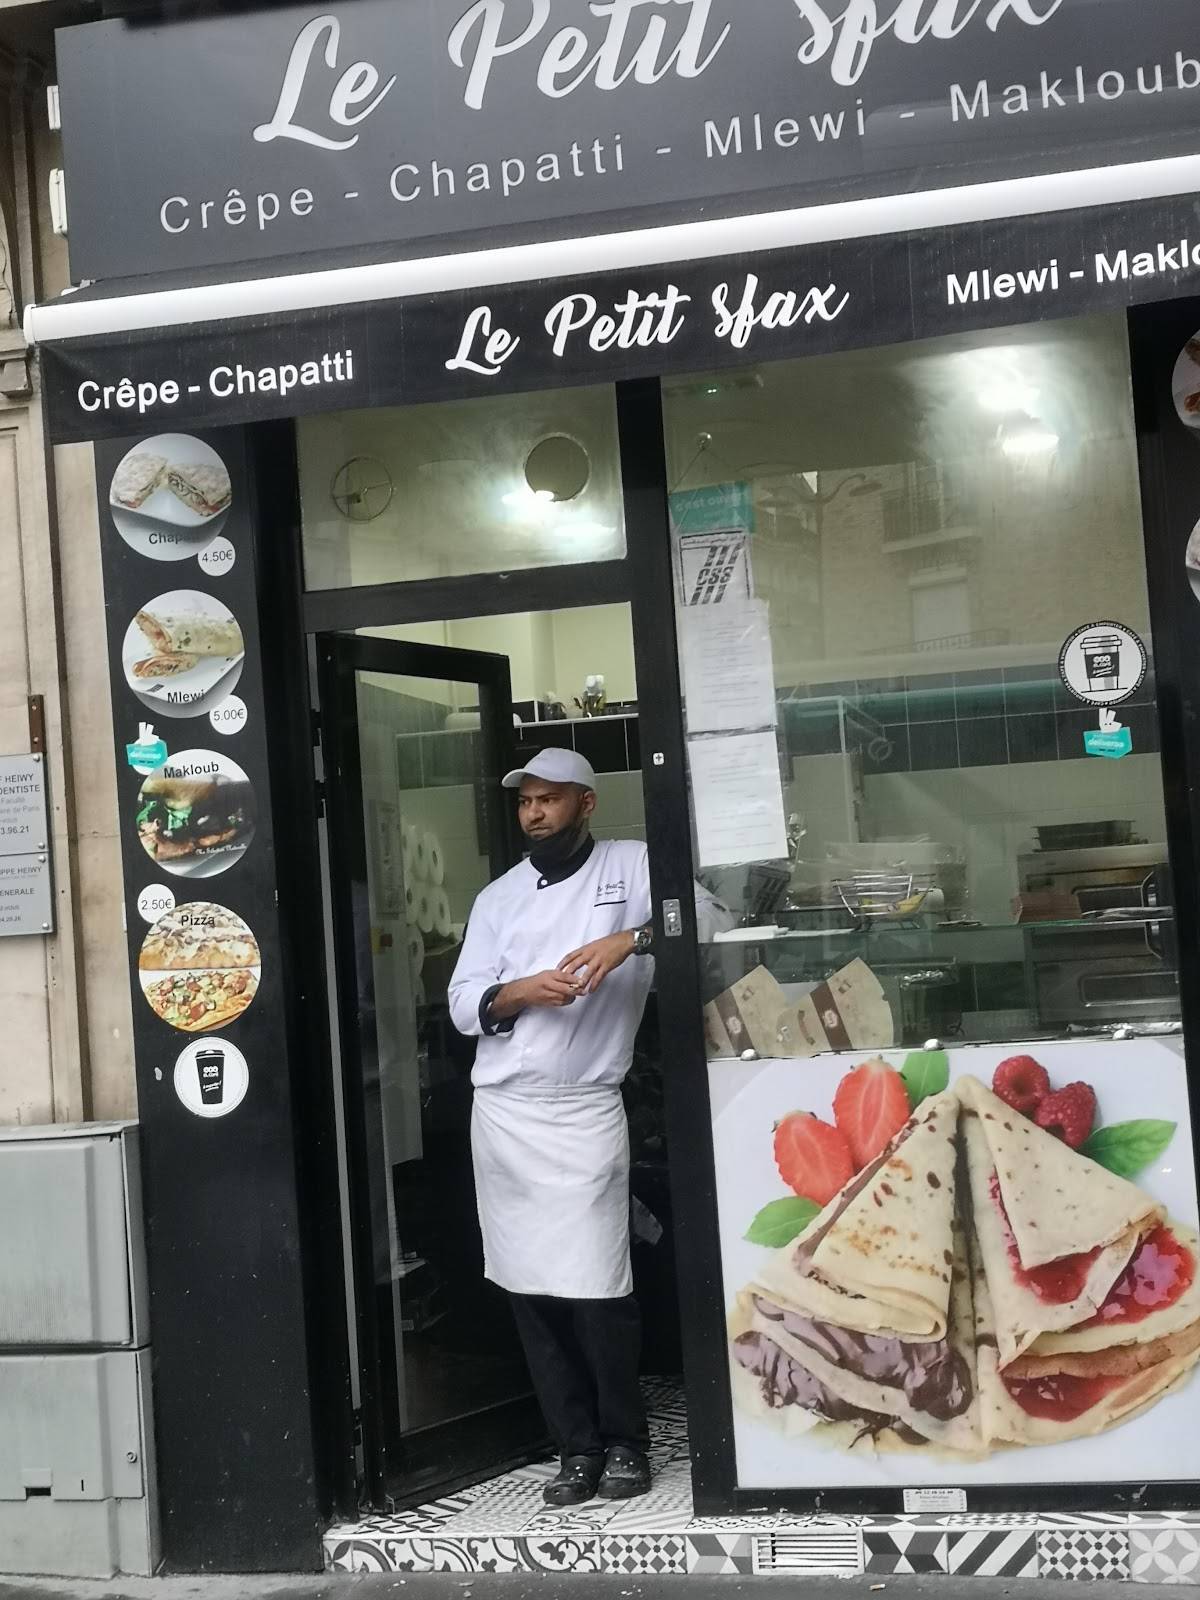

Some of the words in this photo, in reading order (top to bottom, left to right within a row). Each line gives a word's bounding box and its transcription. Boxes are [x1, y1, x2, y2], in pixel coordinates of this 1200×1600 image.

[254, 15, 397, 150] Le
[448, 0, 730, 109] Petit
[160, 188, 314, 234] Crêpe
[389, 134, 623, 202] Chapatti
[704, 98, 865, 158] Mlewi
[950, 51, 1200, 122] Makloub
[946, 258, 1059, 305] Mlewi
[445, 306, 519, 375] Le
[545, 284, 692, 357] Petit
[712, 273, 850, 348] Sfax
[77, 377, 180, 414] Crêpe
[209, 350, 353, 397] Chapatti
[201, 550, 233, 562] 4.50€
[167, 689, 205, 703] Mlewi
[213, 708, 245, 721] 5.00€
[5, 773, 34, 783] HEIWY
[163, 761, 219, 779] Makloub
[141, 898, 172, 910] 2.50€
[181, 914, 215, 927] Pizza
